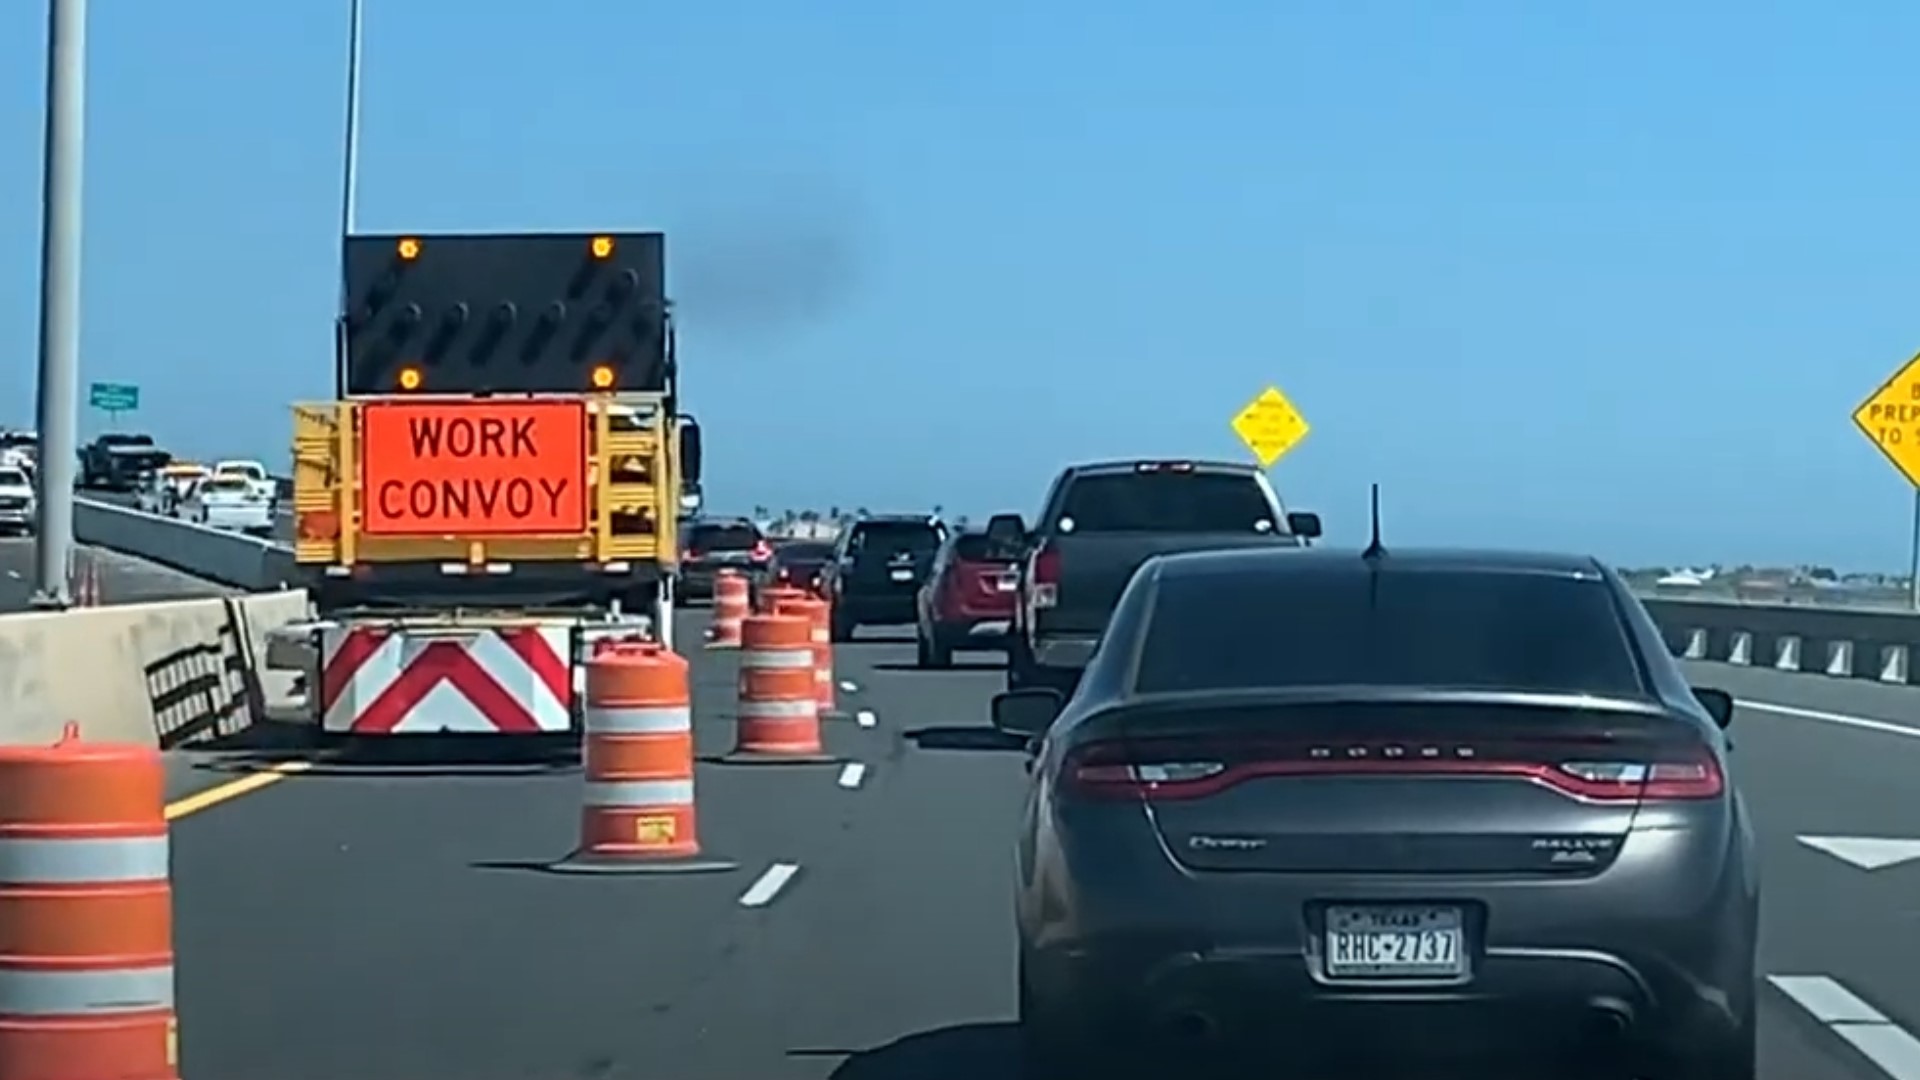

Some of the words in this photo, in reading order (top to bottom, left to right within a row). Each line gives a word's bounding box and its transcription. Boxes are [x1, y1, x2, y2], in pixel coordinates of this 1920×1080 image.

[409, 417, 538, 458] WORK
[1879, 427, 1902, 444] TO
[379, 477, 568, 519] CONVOY
